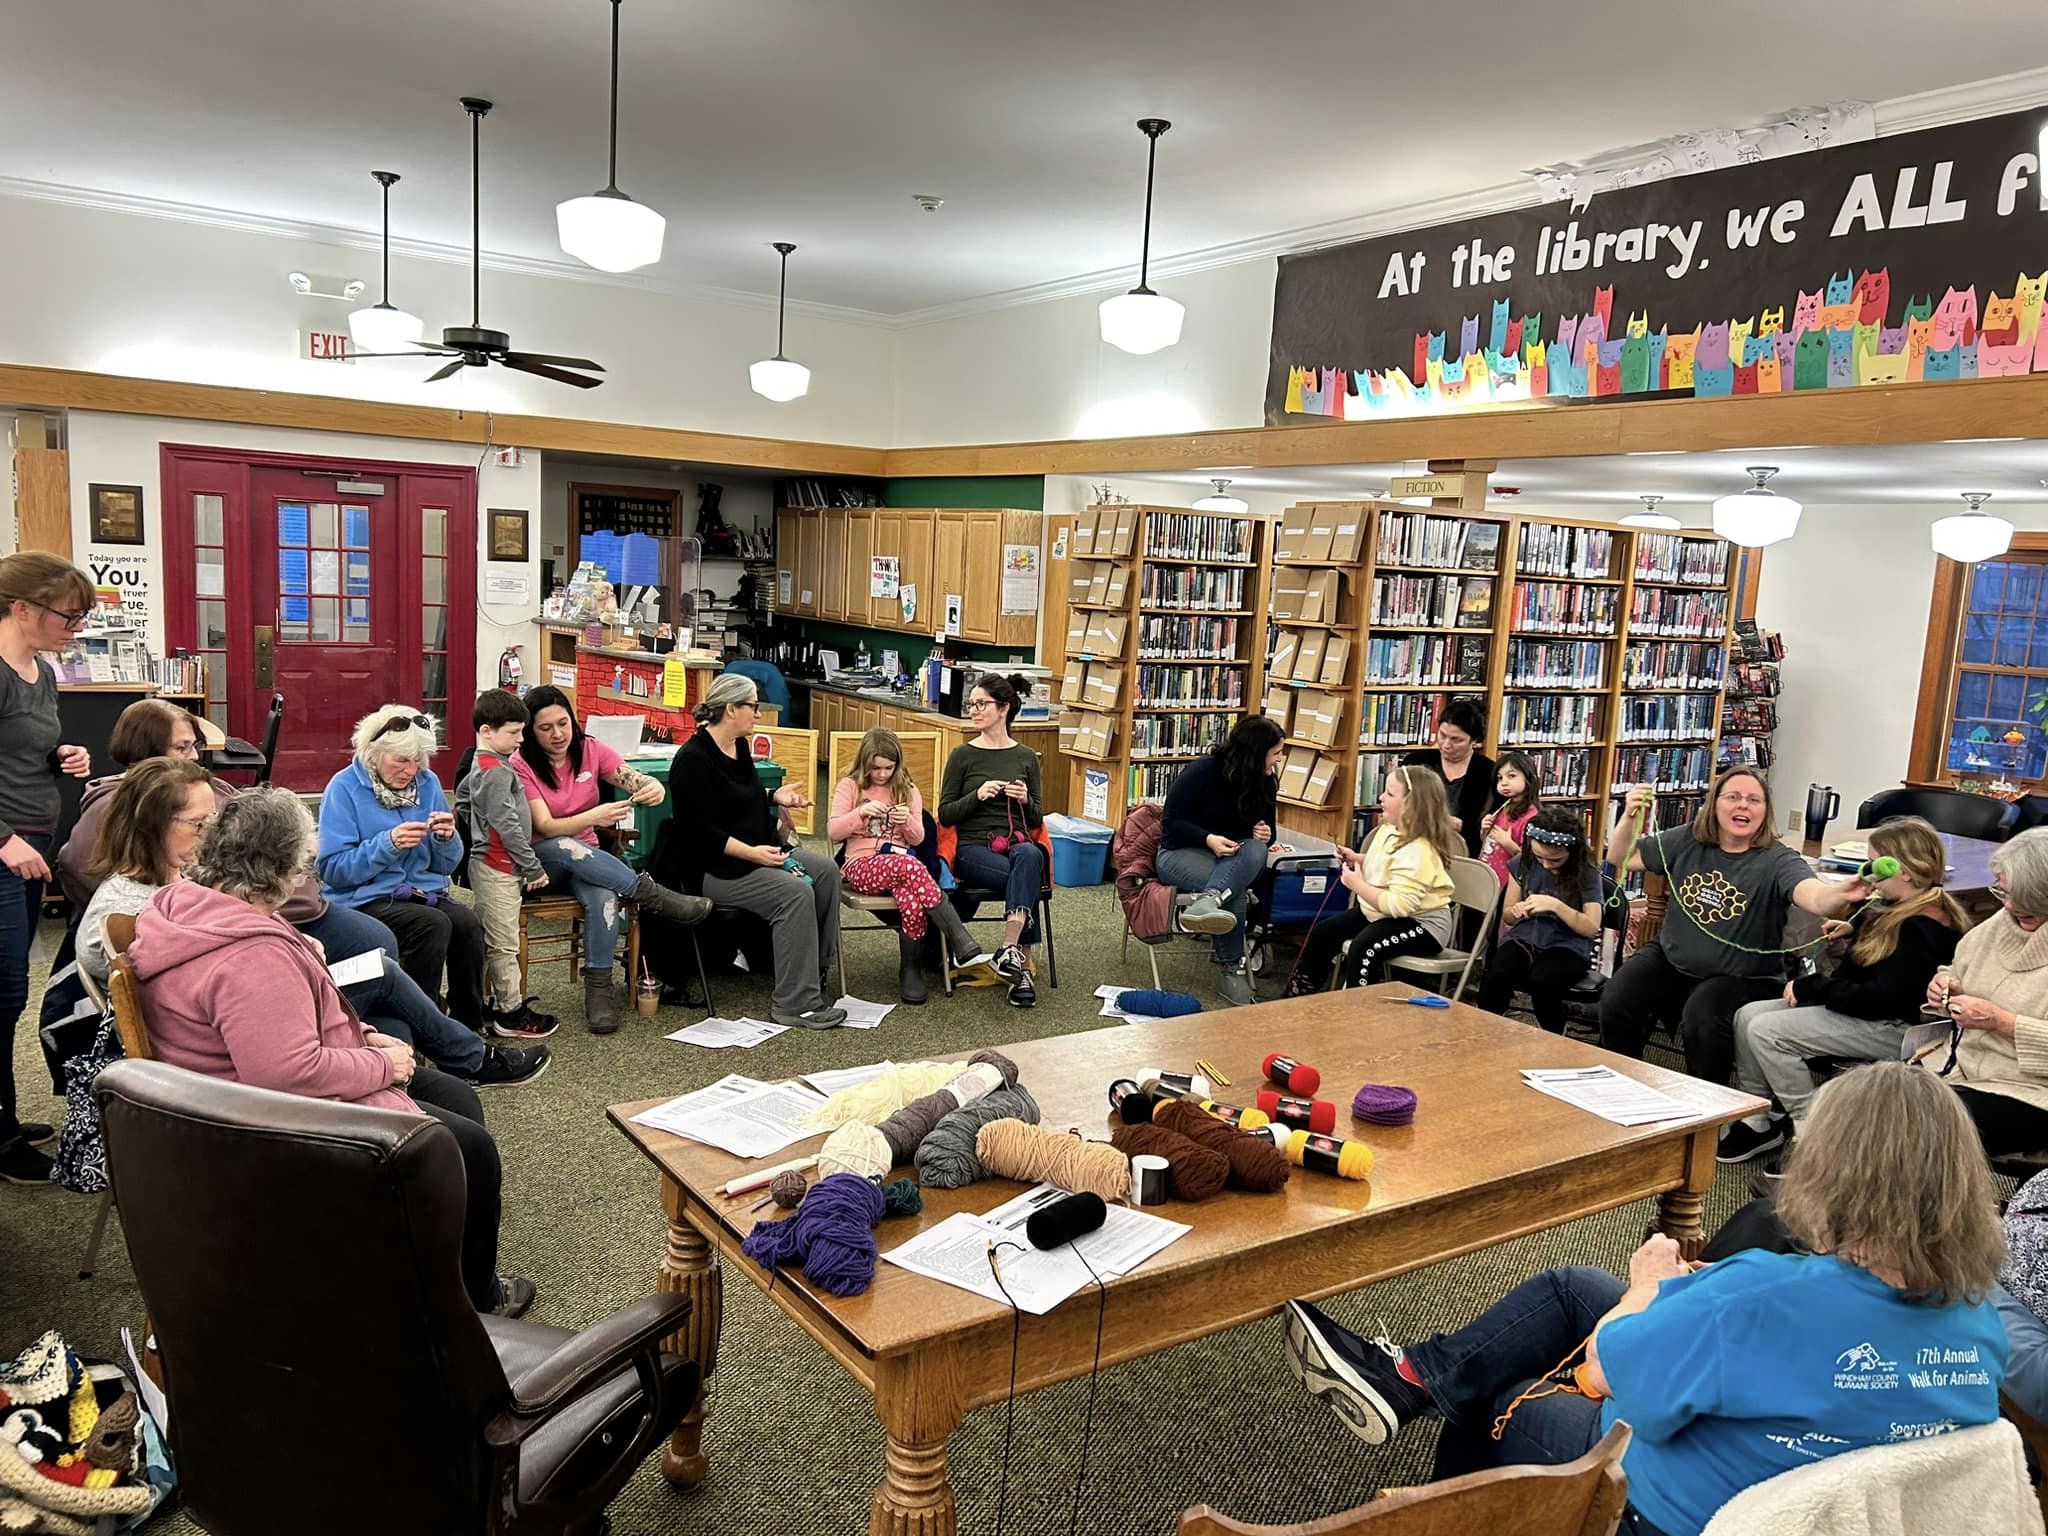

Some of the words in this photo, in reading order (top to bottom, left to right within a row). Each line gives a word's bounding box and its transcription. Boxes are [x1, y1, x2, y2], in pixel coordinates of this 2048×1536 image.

[1376, 251, 1426, 299] At
[1451, 238, 1515, 288] the
[1726, 199, 1805, 250] we
[1829, 160, 1967, 238] ALL
[310, 332, 348, 361] EXIT
[1405, 481, 1445, 494] FICTION
[88, 553, 114, 563] Today
[1916, 1345, 1941, 1365] 17th
[1943, 1345, 1980, 1364] Annual
[1833, 1381, 1869, 1389] HUMANE
[1870, 1381, 1899, 1389] SOCIETY
[1834, 1373, 1871, 1381] WINDHAM
[1907, 1369, 1933, 1389] Walk
[1933, 1369, 1948, 1387] for
[1949, 1368, 1990, 1386] Animals
